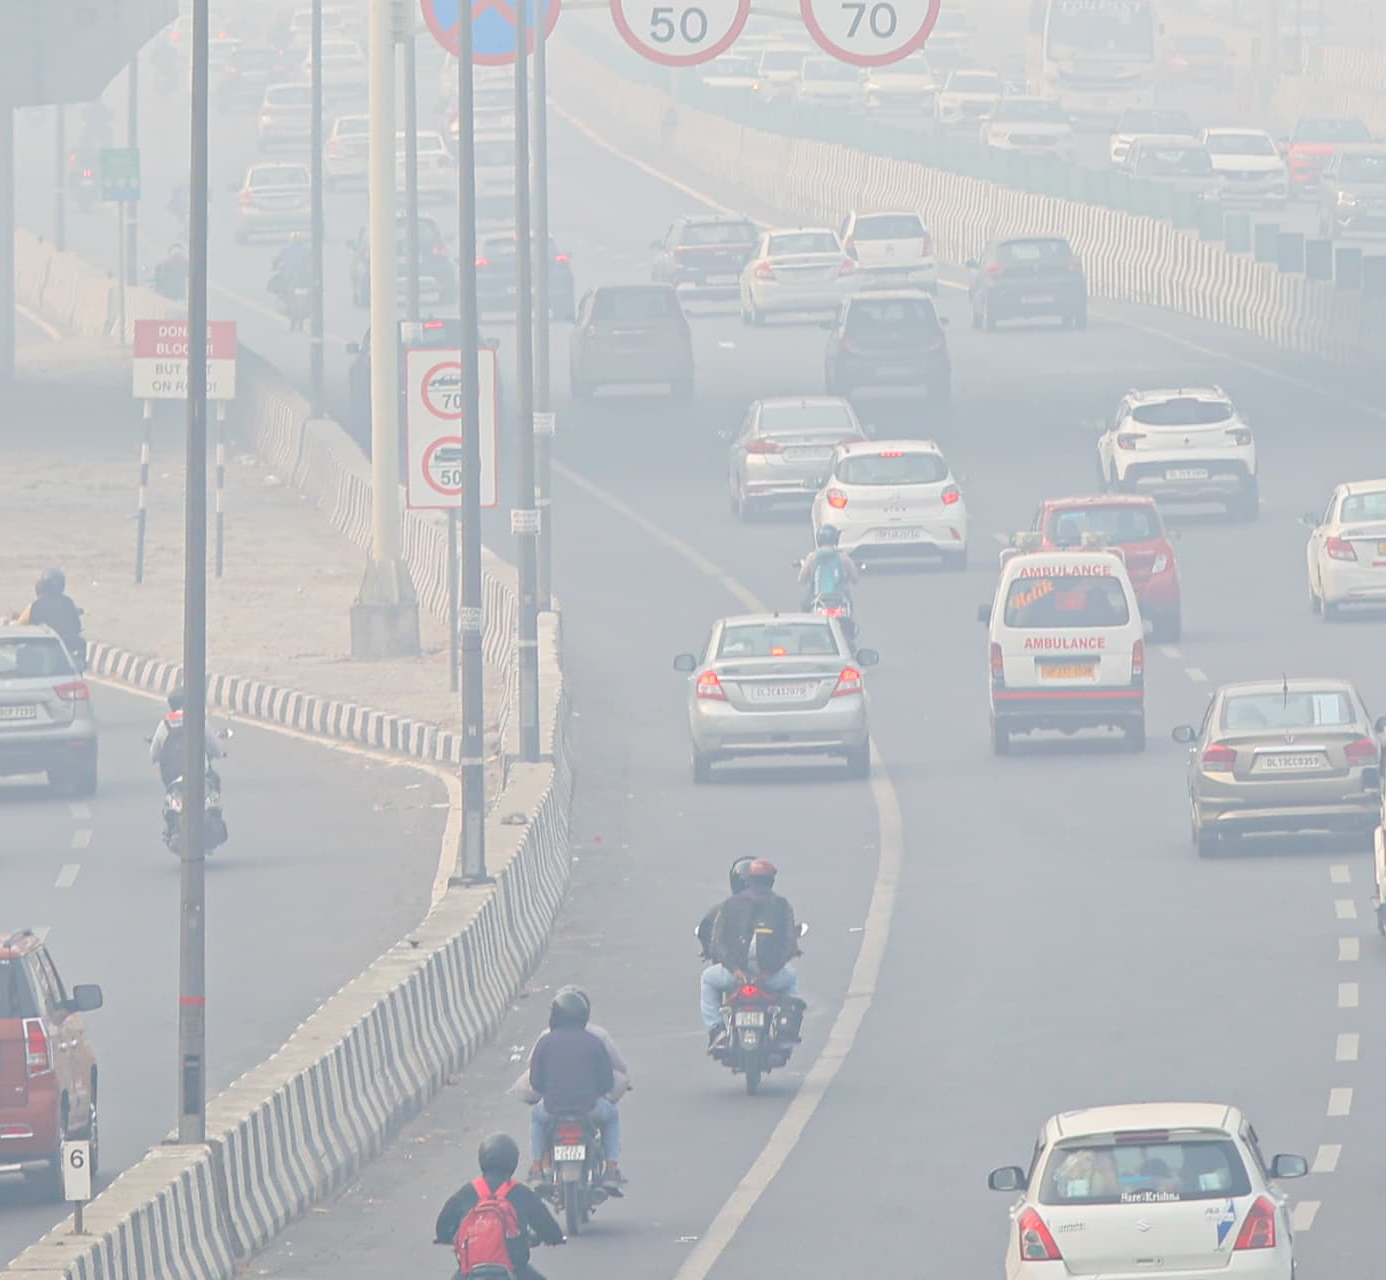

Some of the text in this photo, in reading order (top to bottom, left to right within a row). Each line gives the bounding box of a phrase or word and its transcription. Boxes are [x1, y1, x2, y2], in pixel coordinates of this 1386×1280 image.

[650, 7, 708, 44] 50
[841, 2, 897, 39] 70
[158, 325, 213, 337] DONE
[155, 363, 181, 375] BUT
[151, 380, 171, 392] ON
[442, 393, 462, 409] 70
[441, 470, 462, 486] 50
[1020, 563, 1111, 577] AMBULANCE
[1024, 636, 1107, 649] AMBULANCE
[70, 1149, 84, 1168] 6
